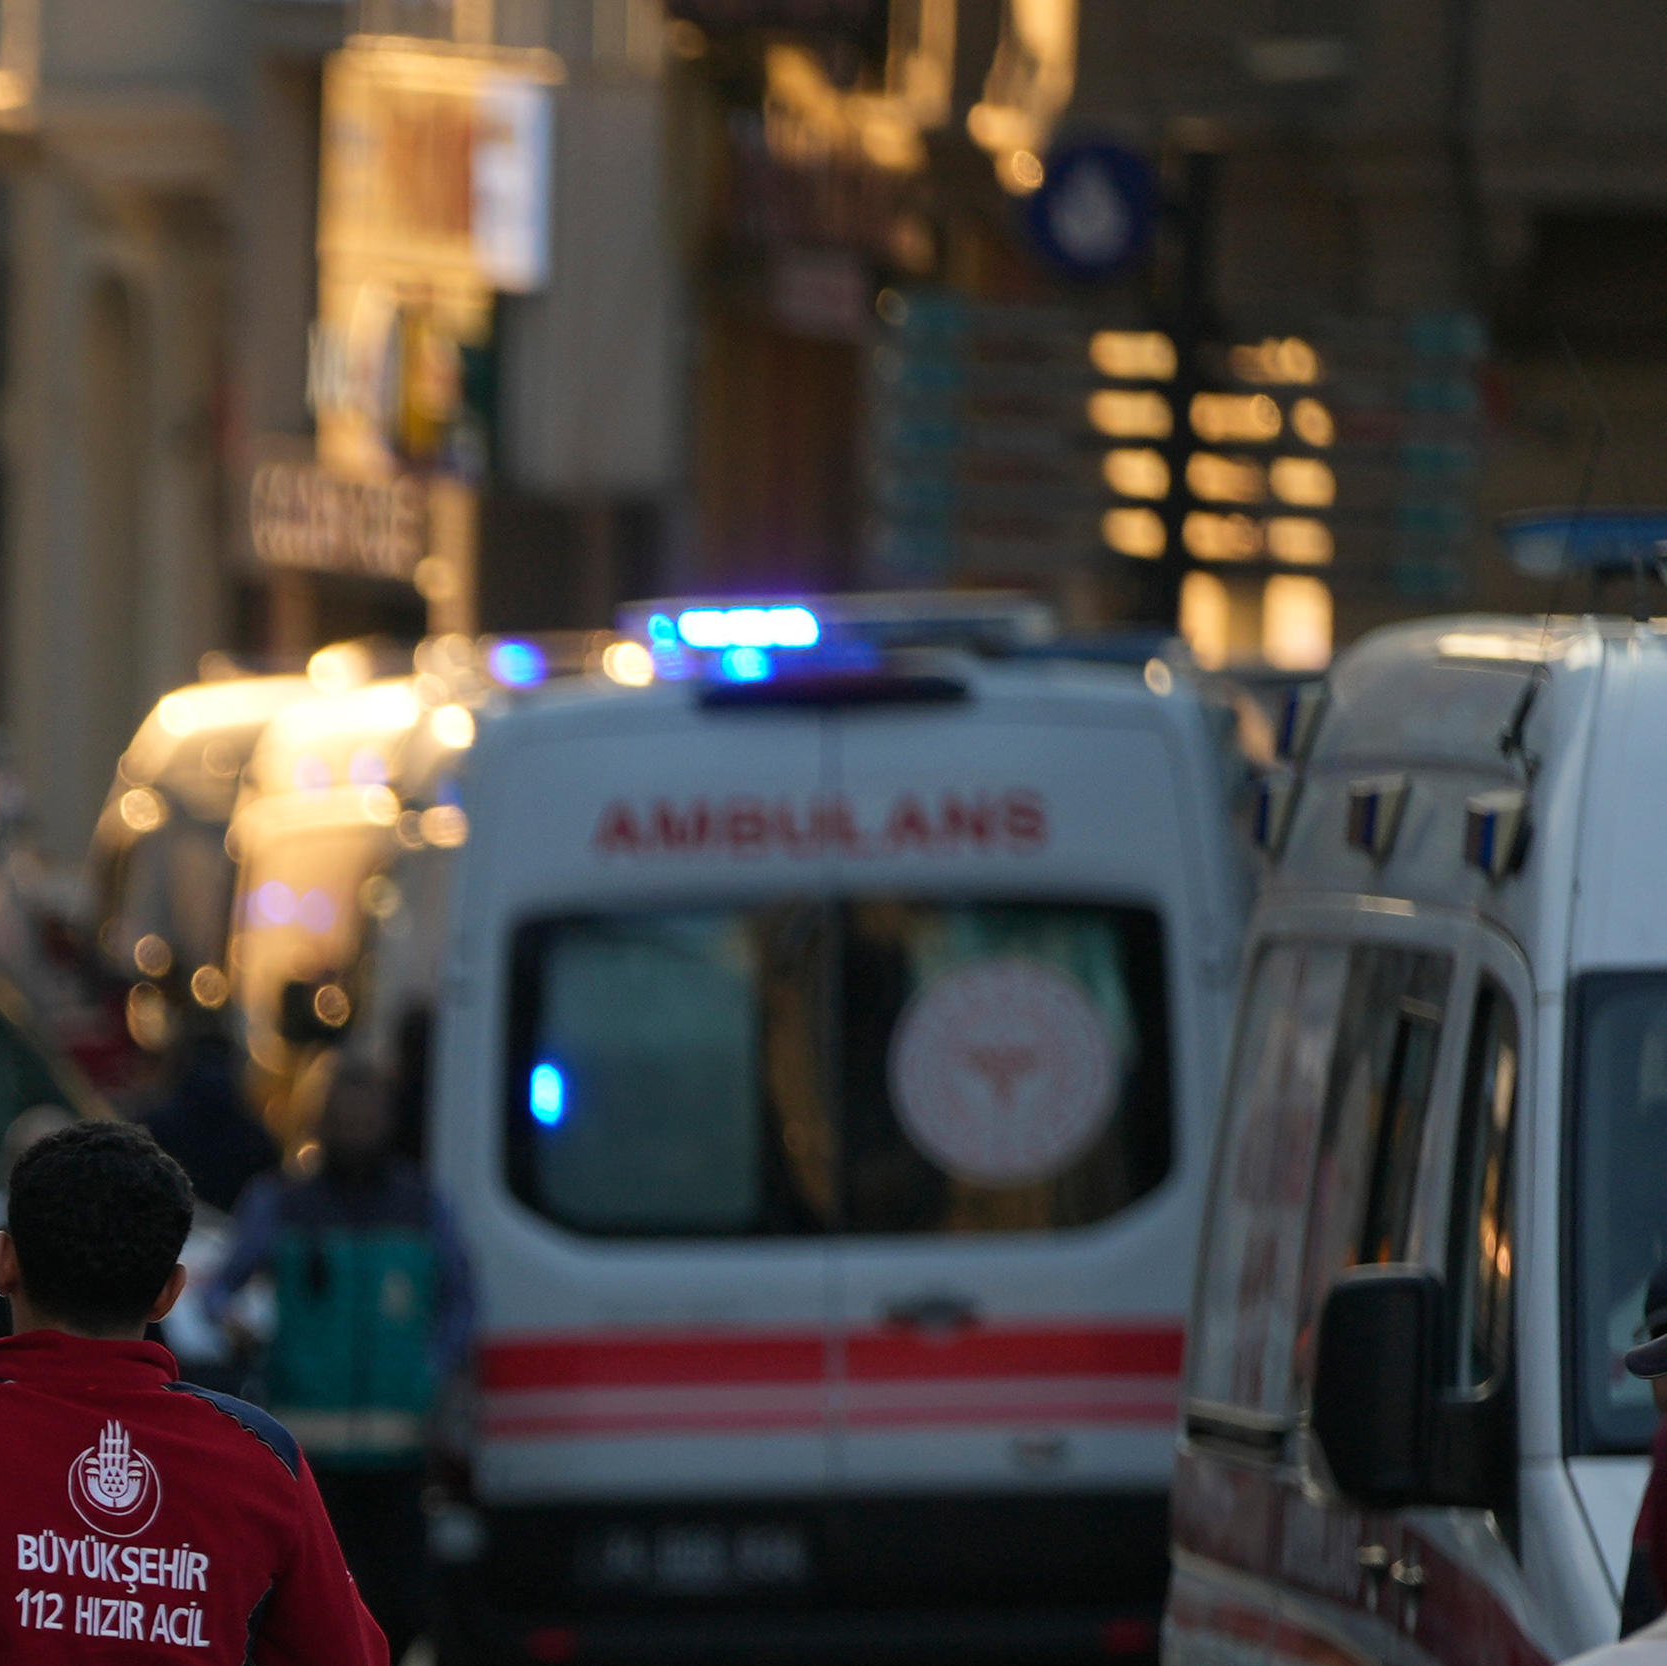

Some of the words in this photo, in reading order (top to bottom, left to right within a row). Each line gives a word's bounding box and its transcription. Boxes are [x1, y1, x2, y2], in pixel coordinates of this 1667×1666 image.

[595, 786, 1048, 857] AMBULANS
[17, 1529, 209, 1594] BÜYÜKŞEHİR
[15, 1588, 64, 1629] 112
[75, 1595, 144, 1641] HIZIR
[149, 1601, 211, 1647] ACİL
